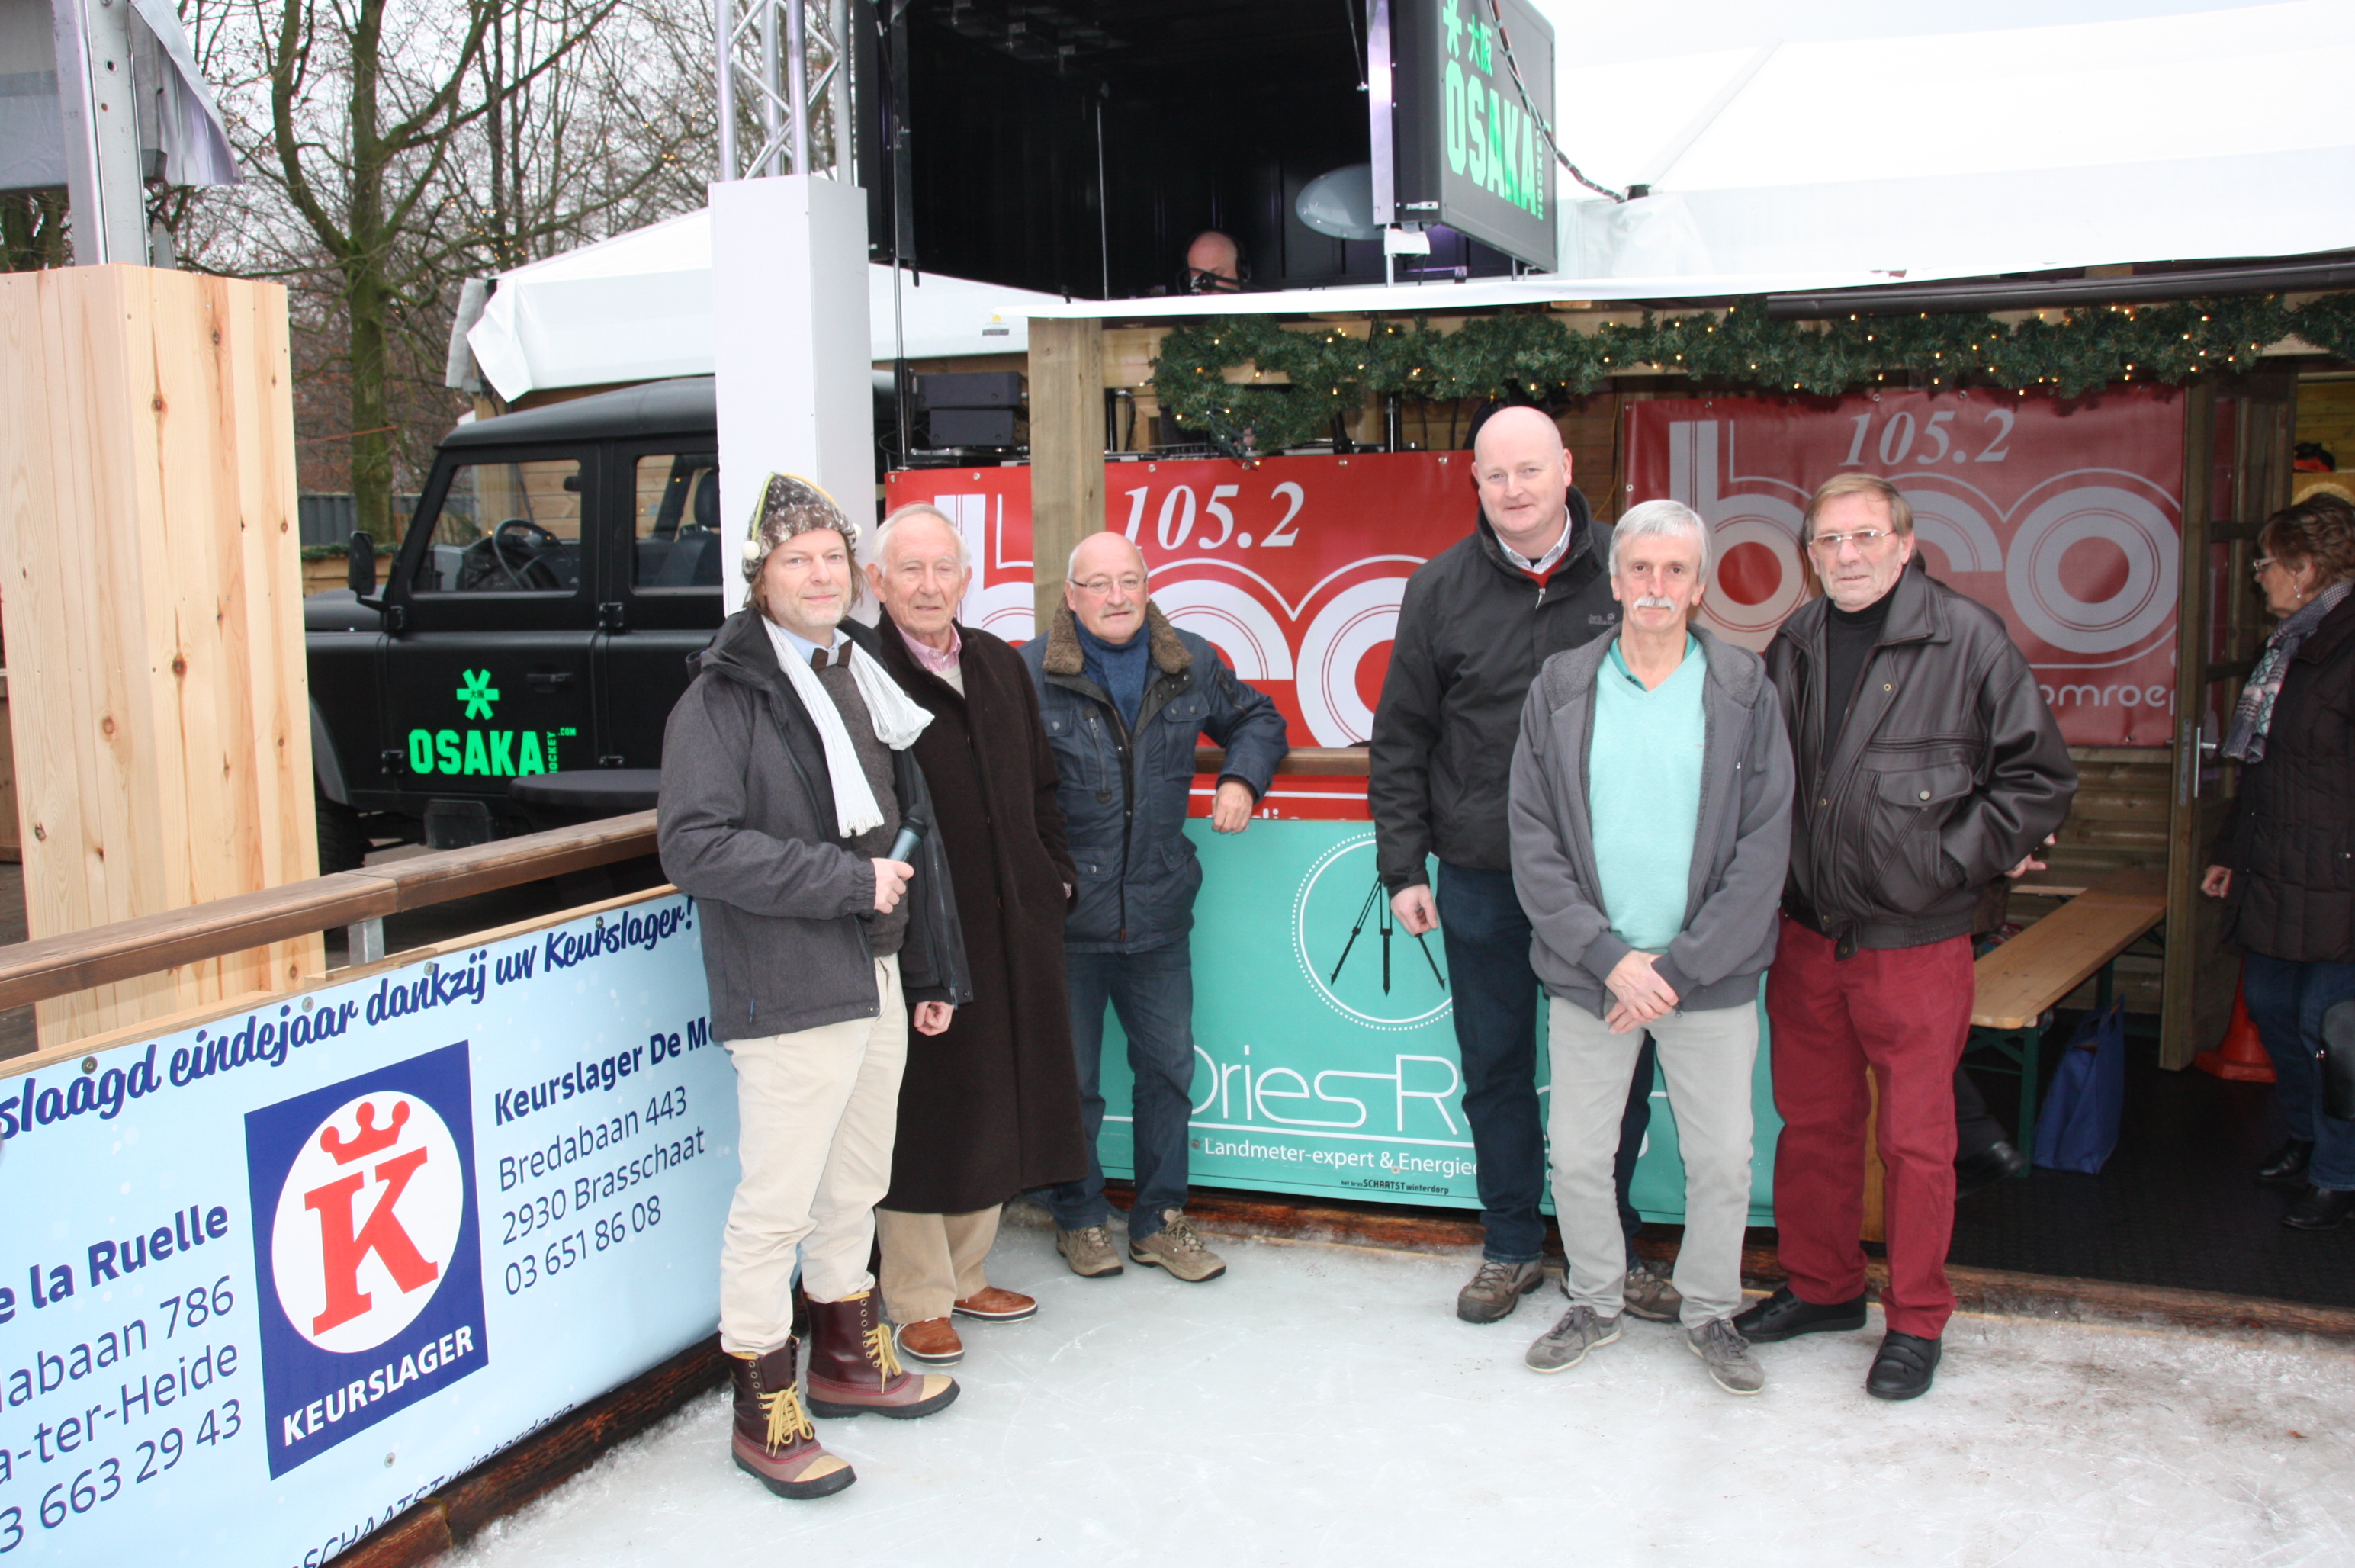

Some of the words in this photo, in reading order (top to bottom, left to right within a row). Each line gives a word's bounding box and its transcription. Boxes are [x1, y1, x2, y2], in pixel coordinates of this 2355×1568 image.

[1445, 59, 1537, 217] OSAKA
[1839, 407, 2016, 466] 105.2
[1123, 480, 1305, 551] 105.2
[408, 728, 545, 776] OSAKA
[169, 1000, 358, 1088] eindejaar
[366, 949, 487, 1027] dankzij
[495, 945, 537, 985] uw
[545, 895, 694, 973] Keurslager!
[494, 1045, 643, 1126] Keurslager
[650, 1032, 681, 1065] De
[499, 1110, 638, 1193] Bredabaan
[645, 1086, 686, 1126] 443
[502, 1188, 567, 1245] 2930
[574, 1126, 705, 1211] Brasschaat
[1204, 1138, 1375, 1169] Landmeter-expert
[1380, 1151, 1393, 1168] &
[29, 1264, 75, 1309] la
[88, 1203, 229, 1287] Ruelle
[304, 1145, 439, 1337] K
[505, 1254, 538, 1296] 03
[545, 1229, 586, 1276] 651
[595, 1211, 625, 1252] 86
[631, 1195, 661, 1232] 08
[0, 1319, 148, 1412] abaan
[159, 1274, 234, 1340] 786
[284, 1325, 474, 1448] KEURSLAGER
[40, 1457, 122, 1529] 663
[135, 1427, 185, 1485] 29
[196, 1399, 243, 1447] 43
